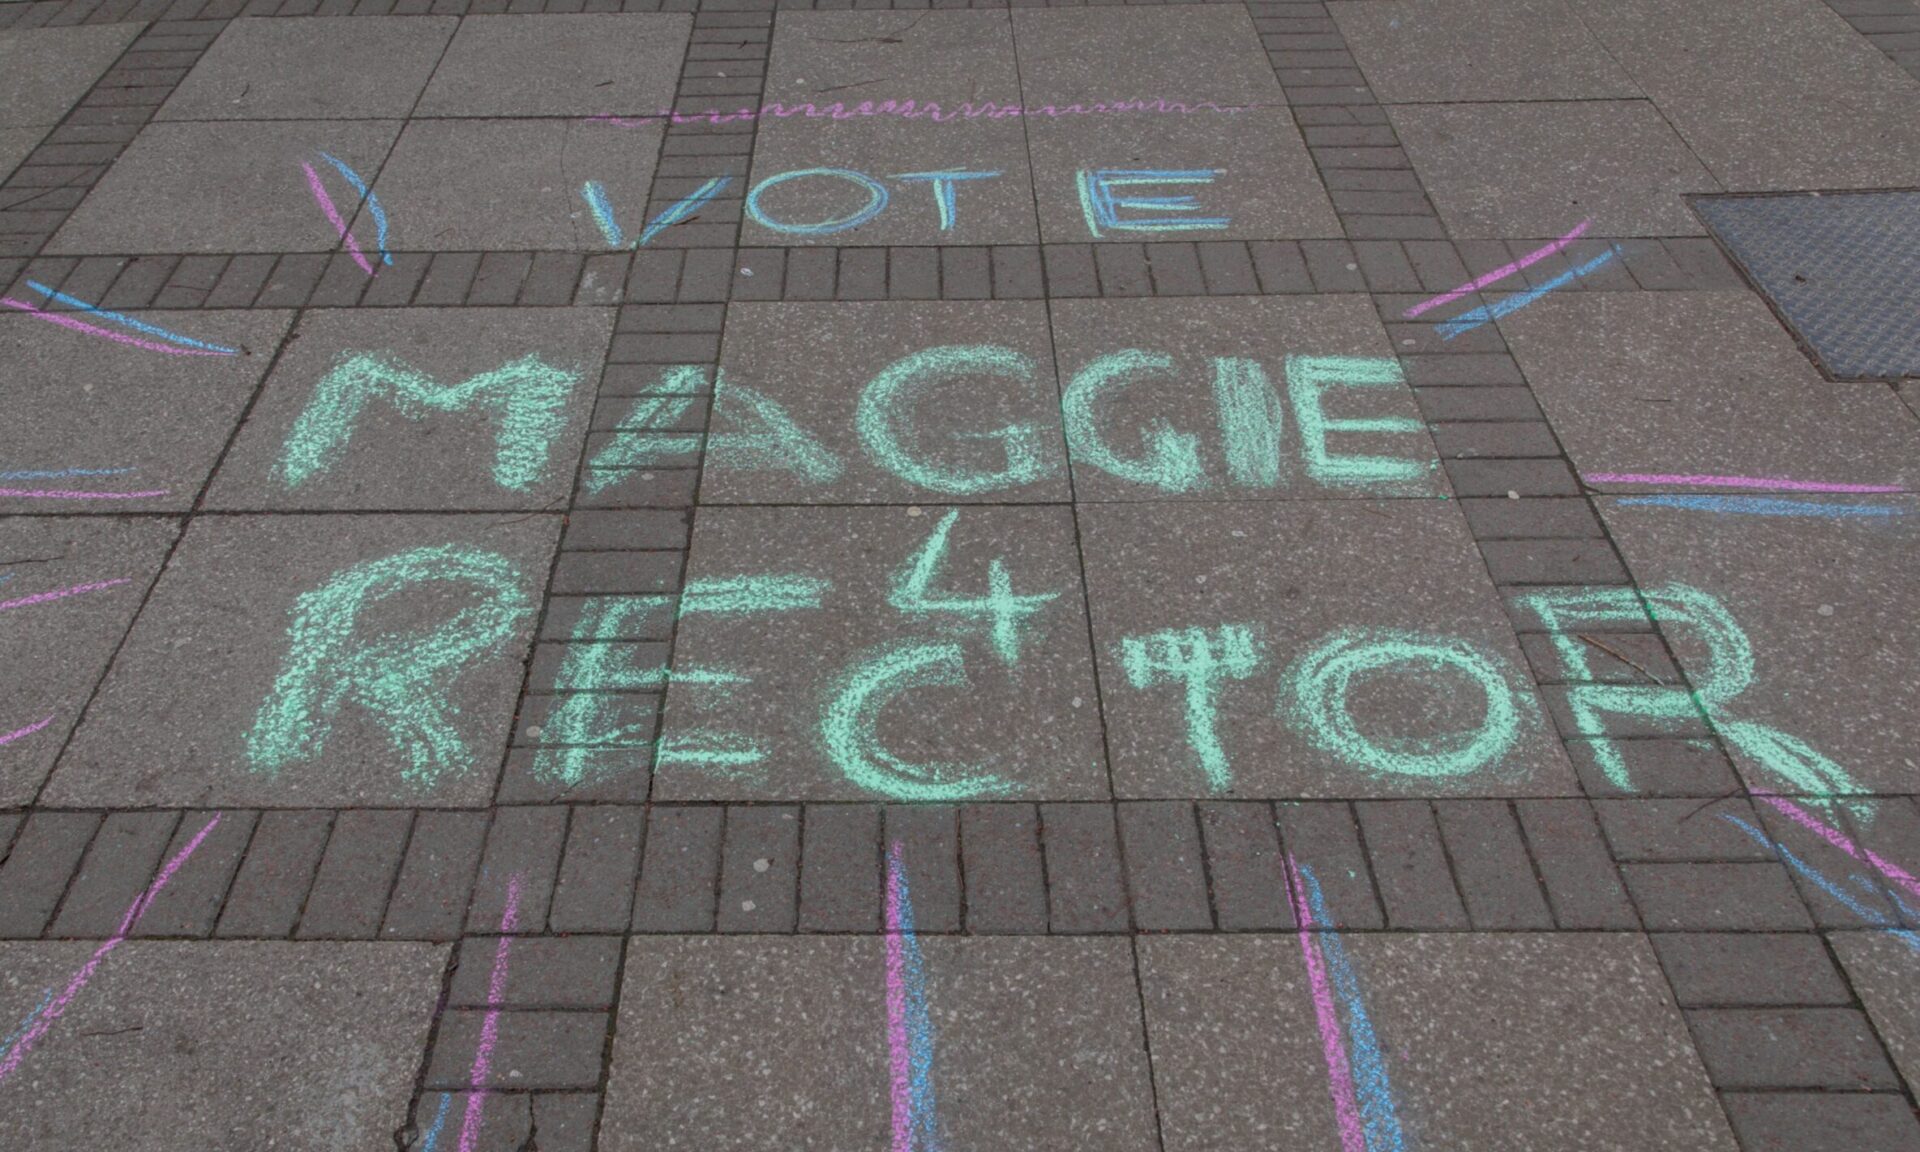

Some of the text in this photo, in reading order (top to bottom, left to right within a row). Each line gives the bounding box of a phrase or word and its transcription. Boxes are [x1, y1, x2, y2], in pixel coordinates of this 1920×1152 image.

[581, 166, 1231, 249] VOTE
[278, 345, 1436, 495] MAGGIE
[886, 508, 1060, 667] 4
[245, 542, 1878, 824] RECTOR
